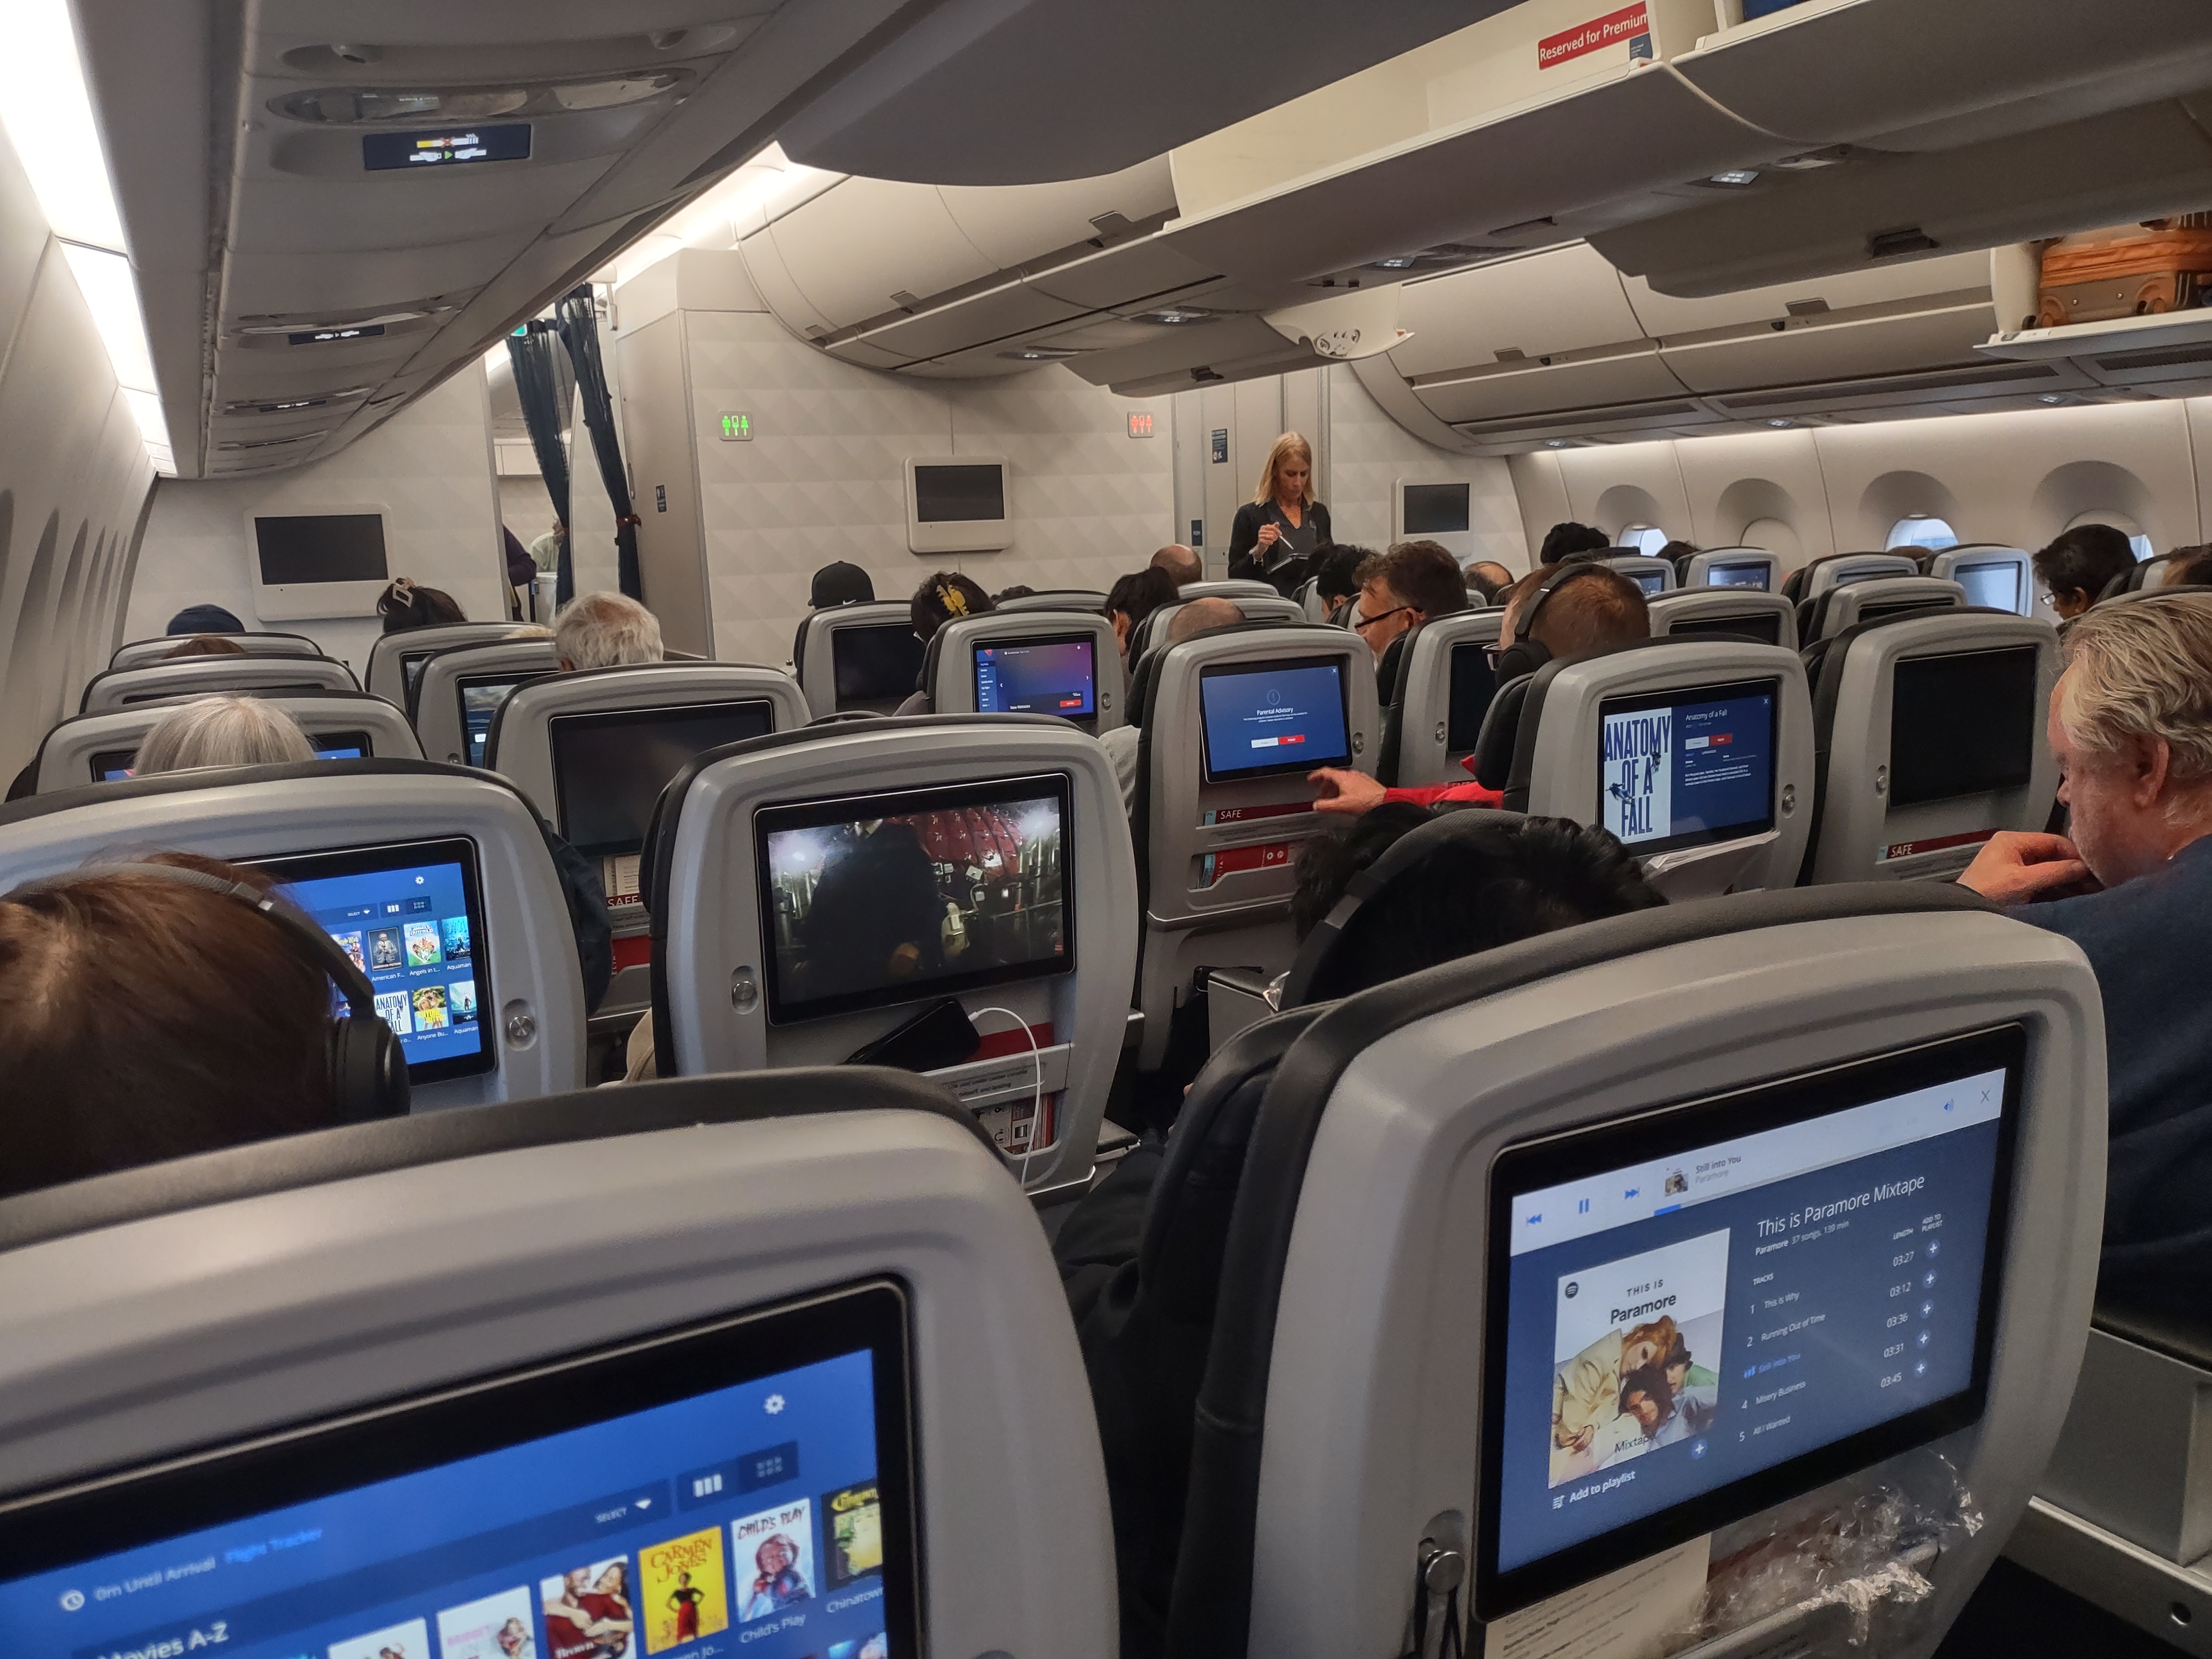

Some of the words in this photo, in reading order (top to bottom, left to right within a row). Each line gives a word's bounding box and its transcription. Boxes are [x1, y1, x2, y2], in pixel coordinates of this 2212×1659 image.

[1540, 33, 1584, 62] Reserved
[1586, 29, 1601, 45] for
[1603, 13, 1648, 39] Premium
[1604, 716, 1671, 763] ANATOMY
[1621, 759, 1639, 797] OF
[1643, 757, 1653, 795] A
[1220, 810, 1242, 820] SAFE
[1621, 796, 1653, 837] FALL
[1890, 844, 1913, 858] SAFE
[447, 962, 471, 971] Aquaman
[376, 994, 407, 1011] ANATOMY
[385, 1008, 394, 1021] OF
[396, 1008, 401, 1020] A
[391, 1020, 403, 1032] ALL
[454, 1026, 478, 1034] Aquaman
[1695, 1162, 1710, 1173] Still
[1711, 1160, 1726, 1170] into
[1727, 1156, 1741, 1165] You
[1757, 1217, 1786, 1238] This
[1789, 1213, 1801, 1229] is
[1804, 1193, 1870, 1224] Paramore
[1873, 1176, 1925, 1203] Mixtape
[1893, 1228, 1914, 1240] LENGTH
[1922, 1220, 1943, 1232] PLAYLIST
[1755, 1240, 1789, 1256] Paramore
[1791, 1235, 1800, 1244] 37
[1836, 1220, 1850, 1230] min
[1892, 1251, 1914, 1267] 03:27
[1626, 1283, 1650, 1297] THIS
[1653, 1279, 1663, 1290] IS
[1752, 1272, 1774, 1286] TRACKS
[1890, 1282, 1911, 1297] 03:12
[1610, 1295, 1677, 1325] Paramore
[1750, 1305, 1755, 1314] 1
[1764, 1300, 1777, 1308] This
[1785, 1292, 1800, 1301] Why
[1886, 1312, 1908, 1328] 03:36
[1747, 1336, 1753, 1347] 2
[1761, 1327, 1788, 1341] Running
[1788, 1322, 1801, 1332] Out
[1802, 1317, 1810, 1327] of
[1810, 1314, 1826, 1324] Time
[1884, 1343, 1904, 1358] 03:31
[1880, 1372, 1902, 1388] 03:45
[1741, 1400, 1747, 1409] 4
[1756, 1392, 1778, 1405] Misery
[1778, 1381, 1806, 1397] Business
[1739, 1431, 1745, 1442] 5
[1569, 1486, 1589, 1503] Add
[1590, 1484, 1601, 1495] to
[1602, 1471, 1636, 1493] playlist
[596, 1506, 628, 1524] SELECT
[738, 1516, 776, 1540] CHILD'S
[780, 1506, 806, 1525] PLAY
[650, 1538, 713, 1569] CARMEN
[123, 1571, 163, 1593] Until
[165, 1556, 216, 1581] Arrival
[657, 1551, 707, 1584] JONES
[187, 1620, 229, 1651] A-Z
[739, 1623, 780, 1644] Child's
[780, 1614, 806, 1629] Play
